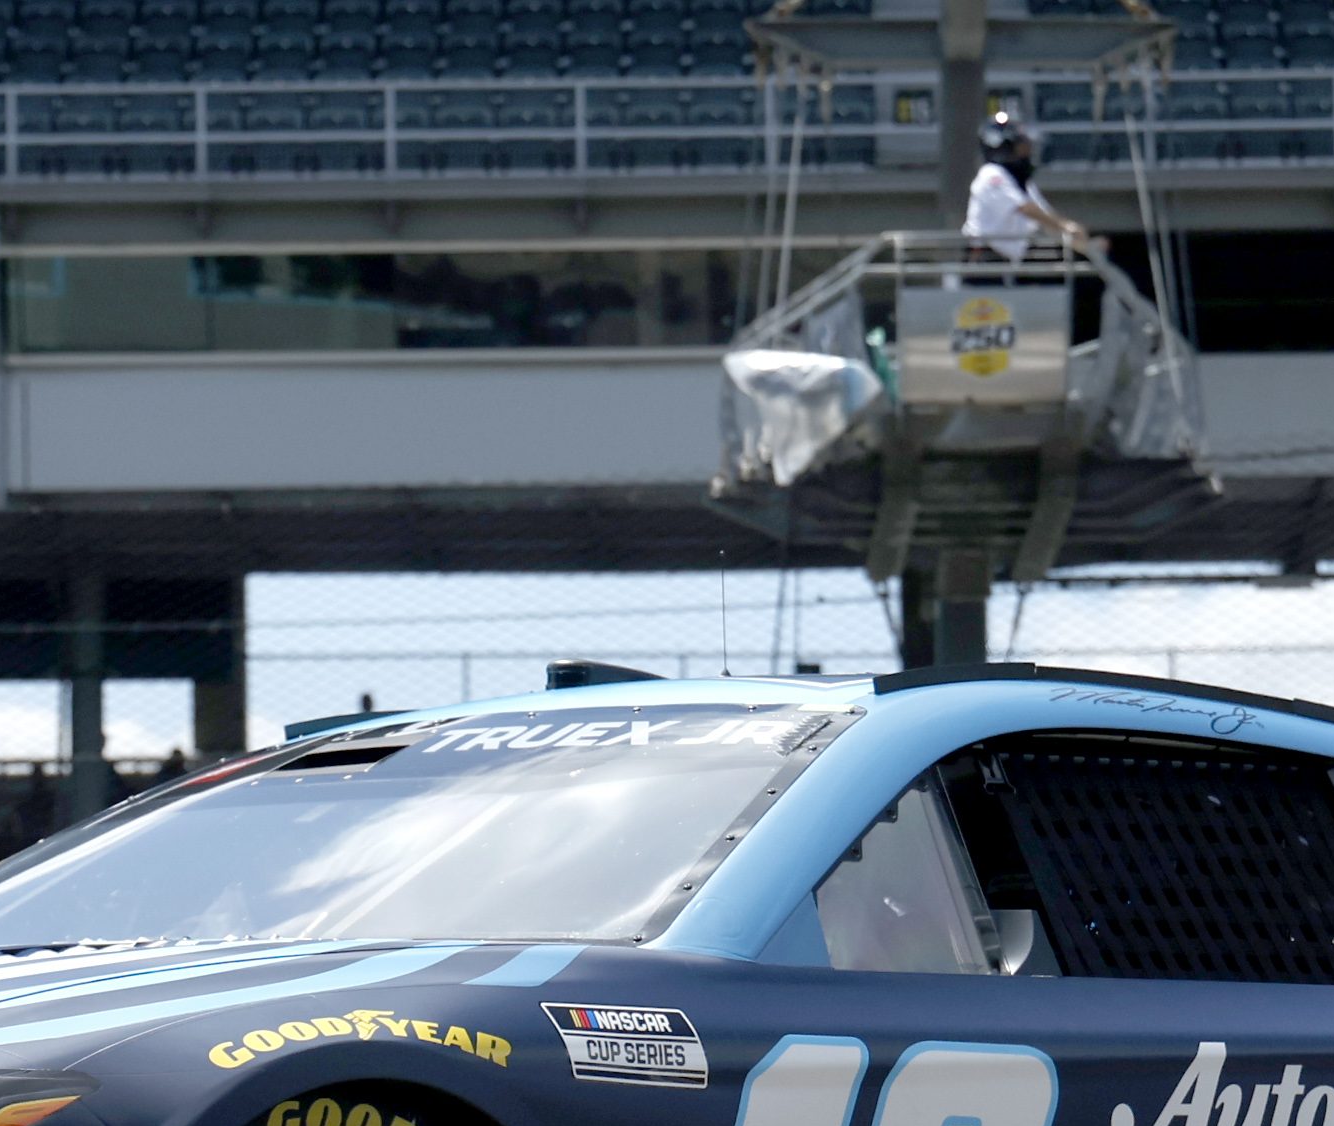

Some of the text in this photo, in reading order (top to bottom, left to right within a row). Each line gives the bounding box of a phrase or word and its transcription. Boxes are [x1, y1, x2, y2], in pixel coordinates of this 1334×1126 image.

[422, 720, 682, 753] TRUEX
[593, 1010, 673, 1033] NASCAR
[587, 1040, 685, 1066] CUP SERIES
